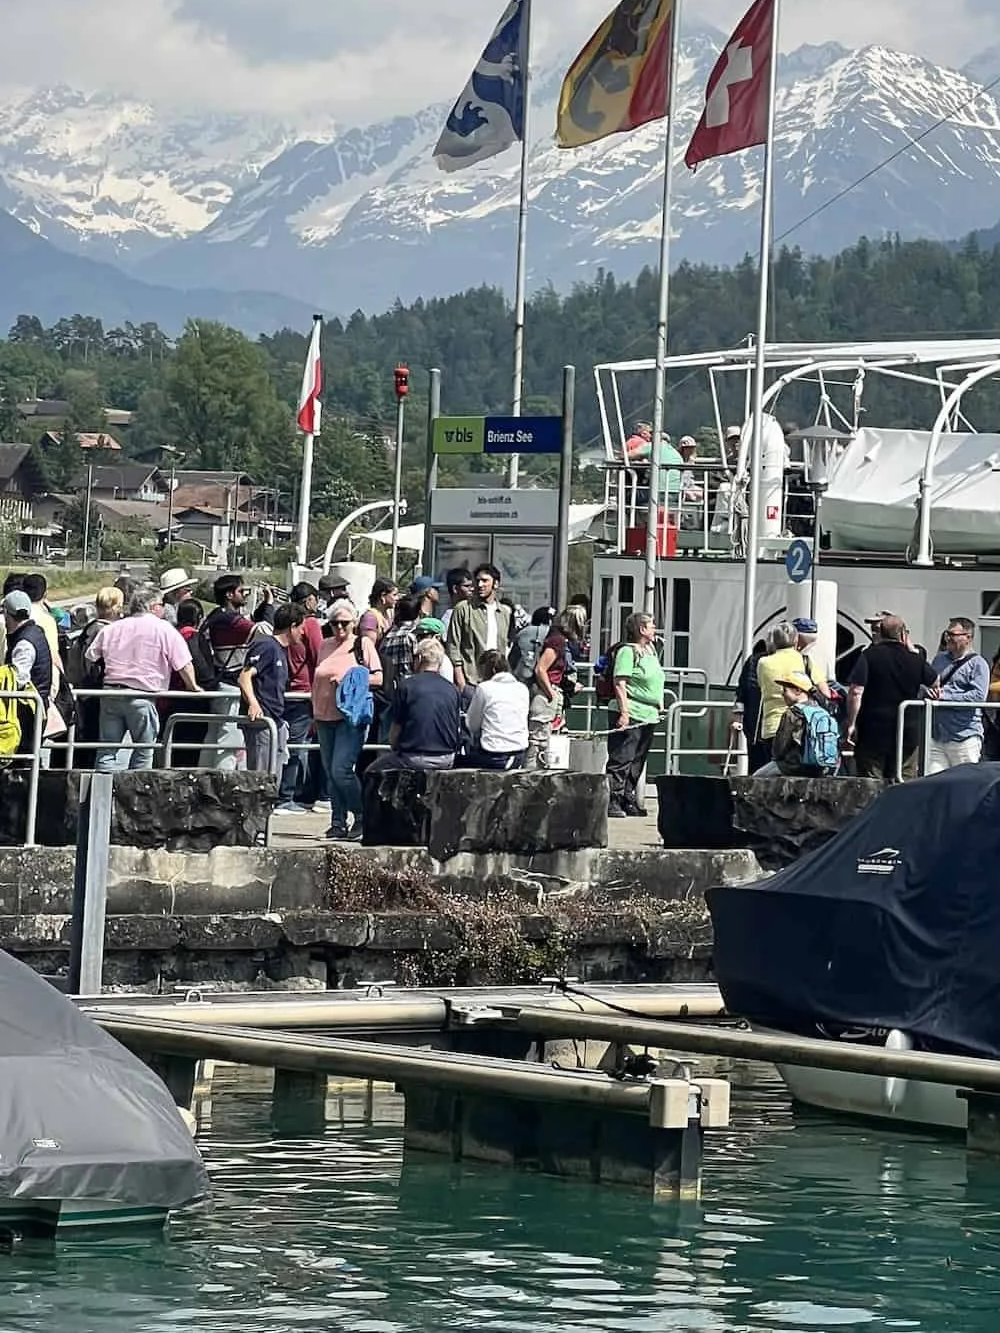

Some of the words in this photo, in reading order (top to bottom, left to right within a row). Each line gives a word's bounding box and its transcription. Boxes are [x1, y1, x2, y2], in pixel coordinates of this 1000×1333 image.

[457, 427, 473, 443] bls
[487, 430, 514, 443] Brienz
[515, 429, 534, 443] See
[792, 547, 804, 576] 2
